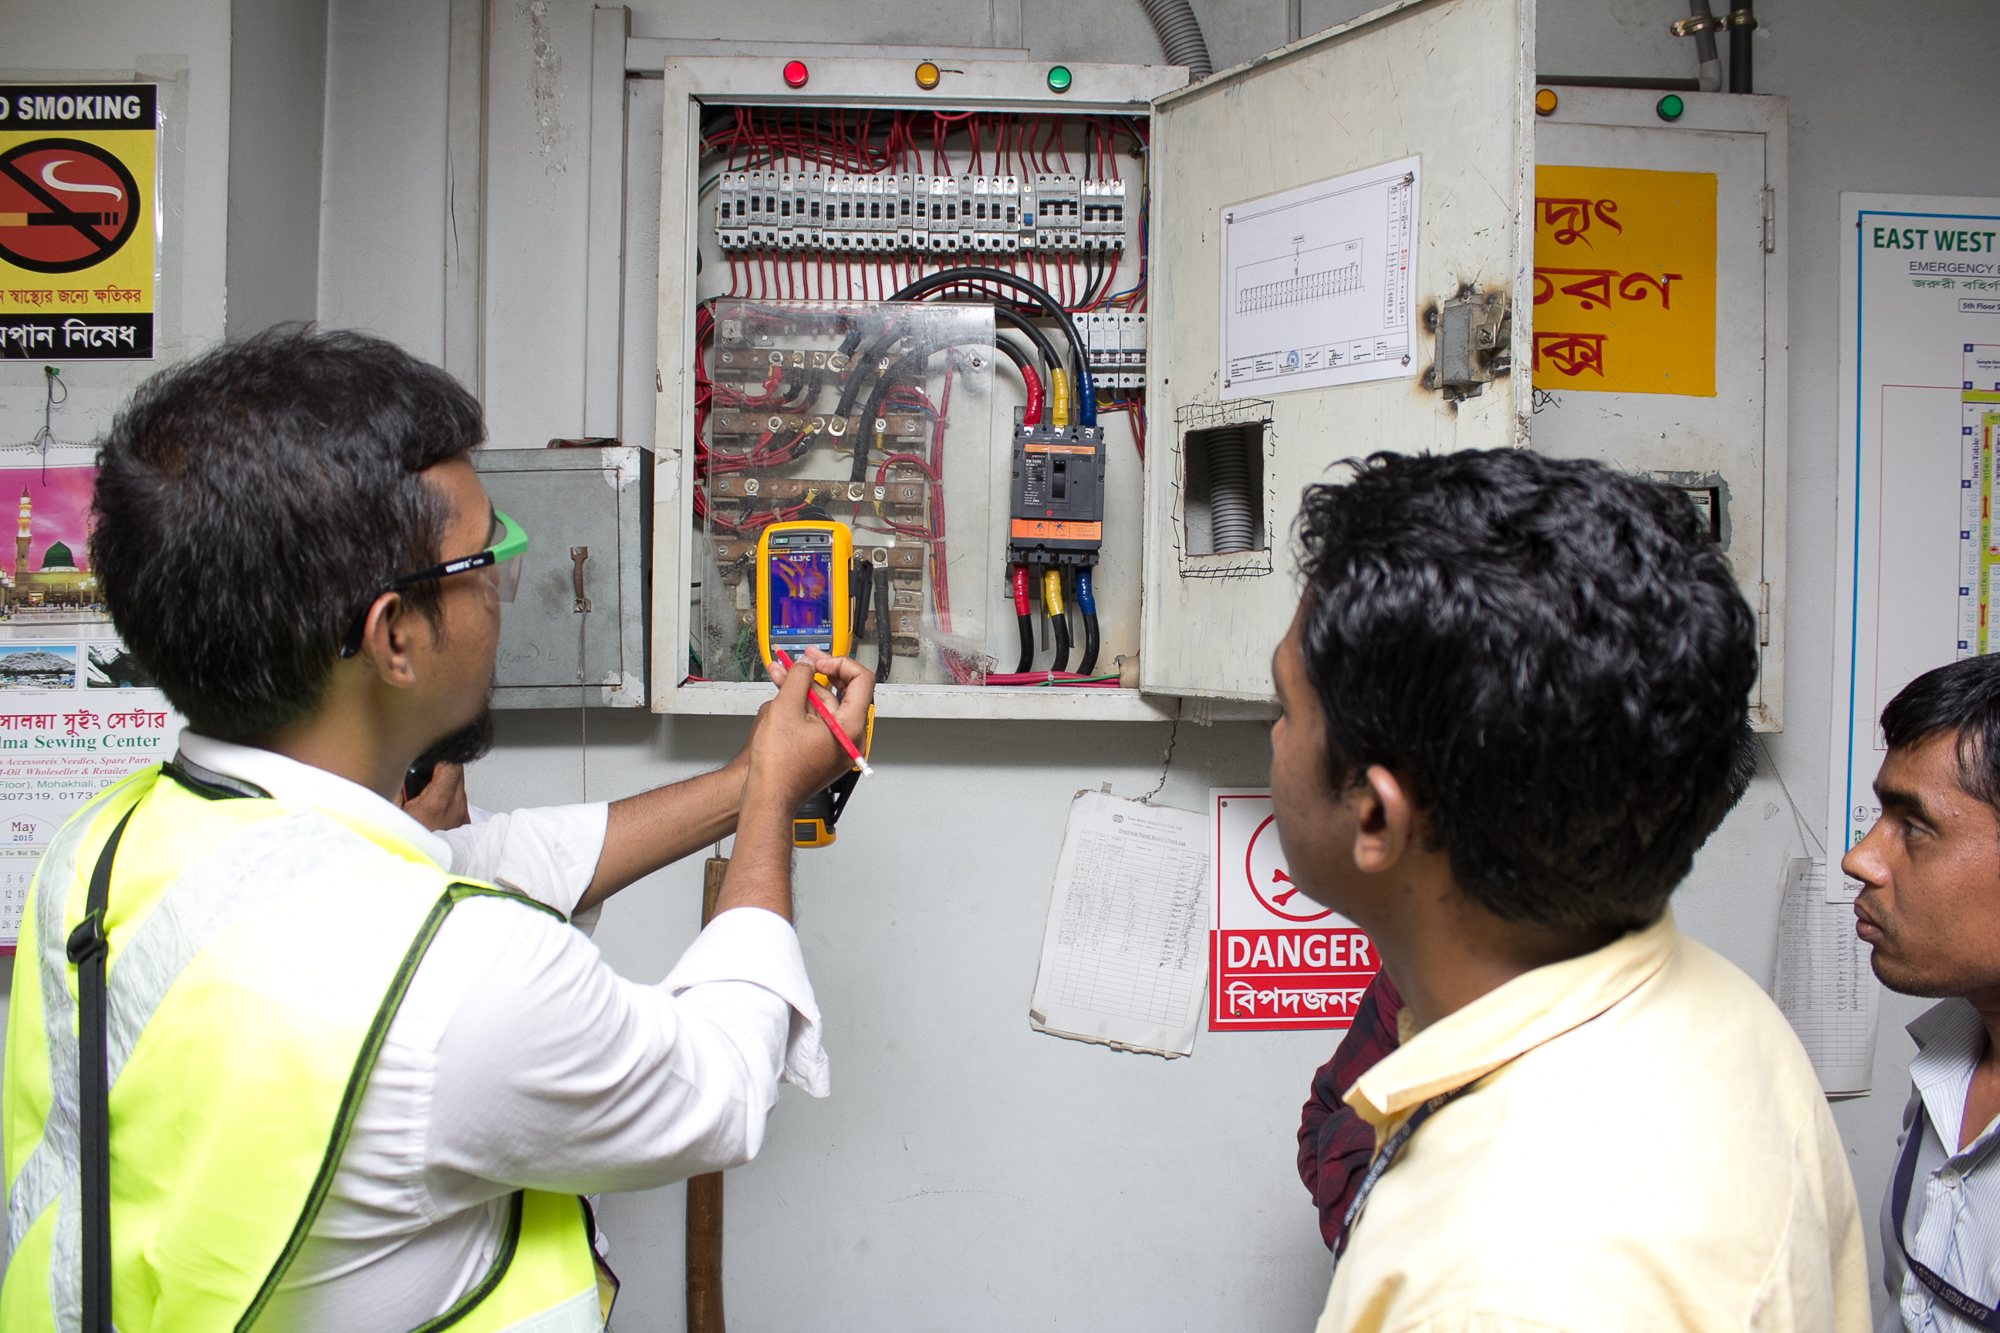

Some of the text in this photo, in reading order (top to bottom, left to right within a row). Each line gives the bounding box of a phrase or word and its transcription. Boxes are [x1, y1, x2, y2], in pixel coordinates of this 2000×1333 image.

[18, 95, 142, 121] SMOKING
[1873, 227, 1996, 252] EAST WEST
[1909, 261, 1994, 274] EMERGENCY
[93, 284, 142, 304] ক্ষতিকর
[1976, 302, 1996, 310] Floor
[61, 318, 137, 348] নিষেধ
[63, 709, 101, 736] সুইং
[107, 708, 168, 730] সেন্টার
[34, 734, 97, 752] Sewing
[102, 734, 160, 748] Center
[60, 757, 97, 765] Needles,
[100, 757, 126, 765] Spare
[129, 756, 151, 764] Parts
[26, 768, 79, 776] Wholeseller
[92, 767, 129, 775] Retailer.
[37, 780, 97, 789] Mohakhali,
[11, 822, 37, 834] May
[1119, 828, 1139, 837] Electrical
[7, 874, 24, 883] 5 6
[1844, 882, 1866, 893] Desig
[5, 889, 25, 899] 12 13
[4, 904, 25, 914] 19 20
[2, 920, 11, 929] 26
[1227, 934, 1371, 968] DANGER
[1940, 1286, 1963, 1306] WEST
[1961, 1299, 1988, 1320] EAST
